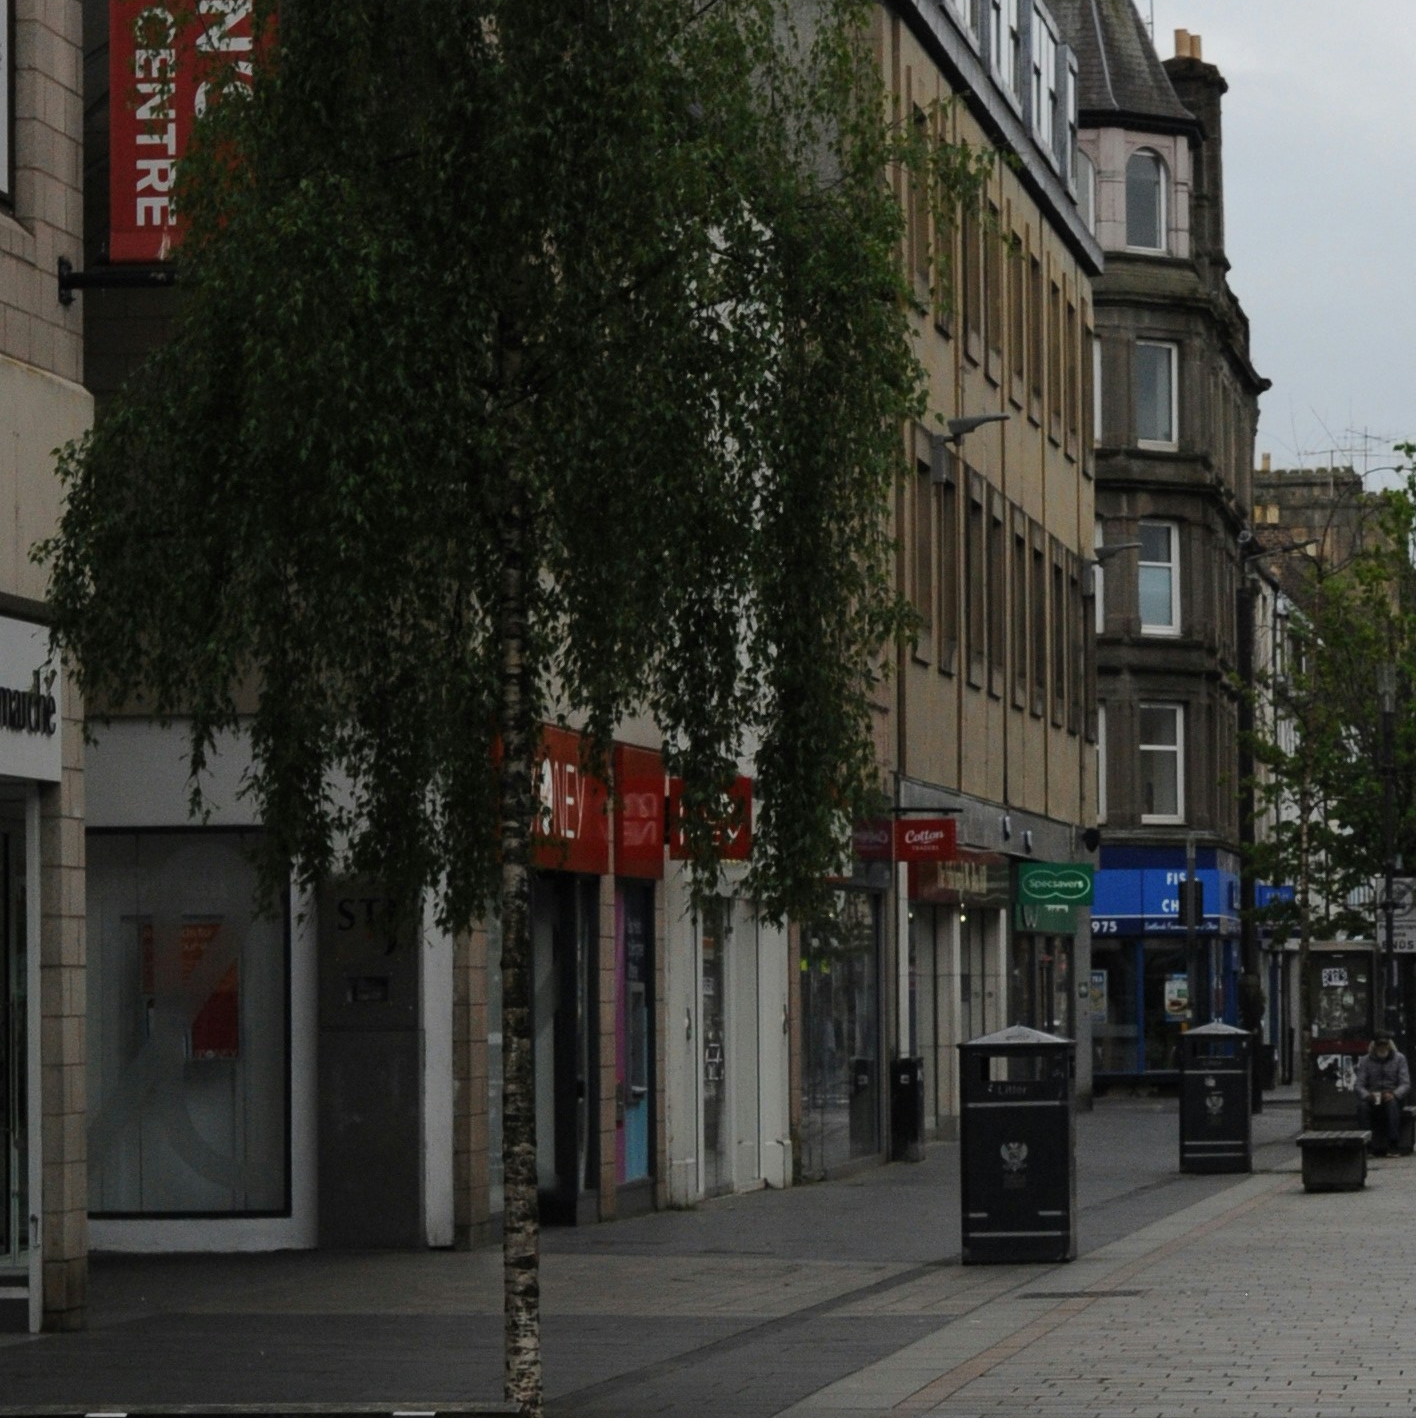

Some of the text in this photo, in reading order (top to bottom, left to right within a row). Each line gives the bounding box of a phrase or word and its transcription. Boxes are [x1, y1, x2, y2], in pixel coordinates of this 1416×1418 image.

[135, 7, 177, 227] CENTRE
[904, 828, 945, 845] Cotton
[1028, 877, 1084, 891] Specsavers
[997, 1084, 1027, 1095] Litter
